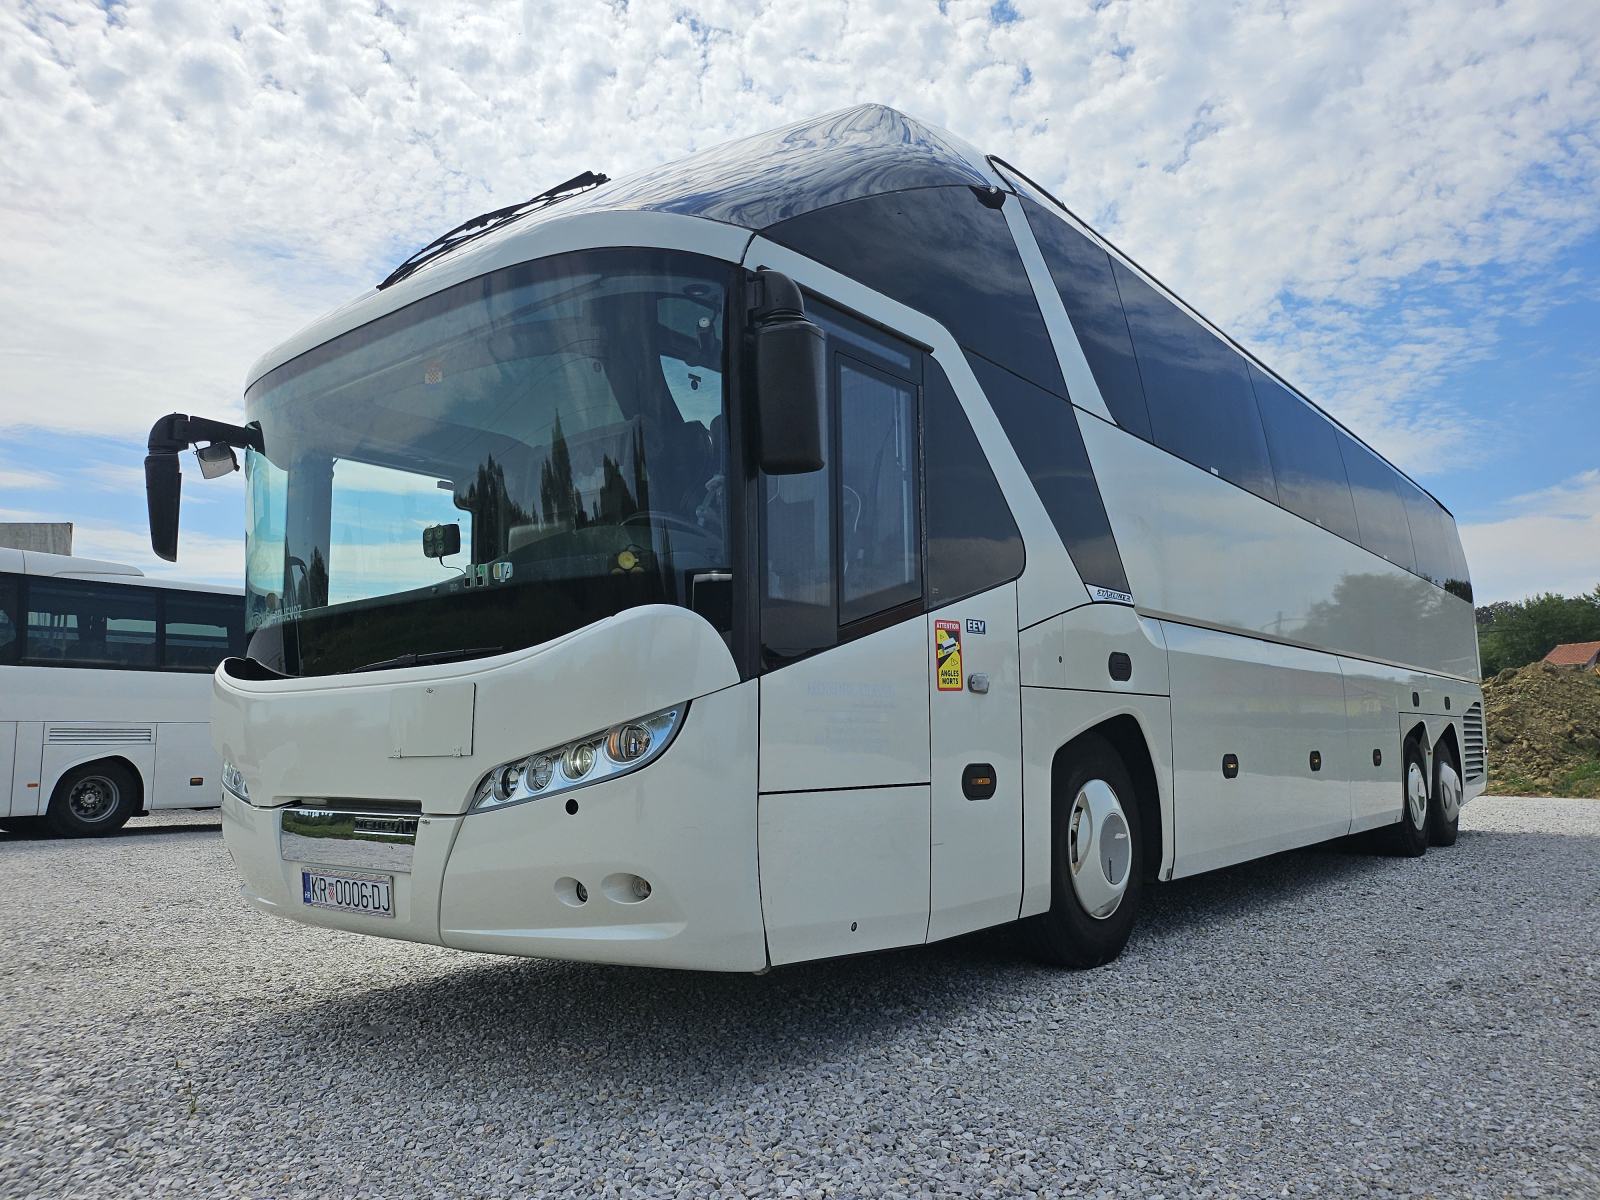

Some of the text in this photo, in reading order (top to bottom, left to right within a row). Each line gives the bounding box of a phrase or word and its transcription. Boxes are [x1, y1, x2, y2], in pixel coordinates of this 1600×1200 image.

[967, 619, 985, 632] EEV
[941, 669, 960, 678] ANGLES
[942, 677, 959, 685] MORTS
[311, 876, 328, 902] KR
